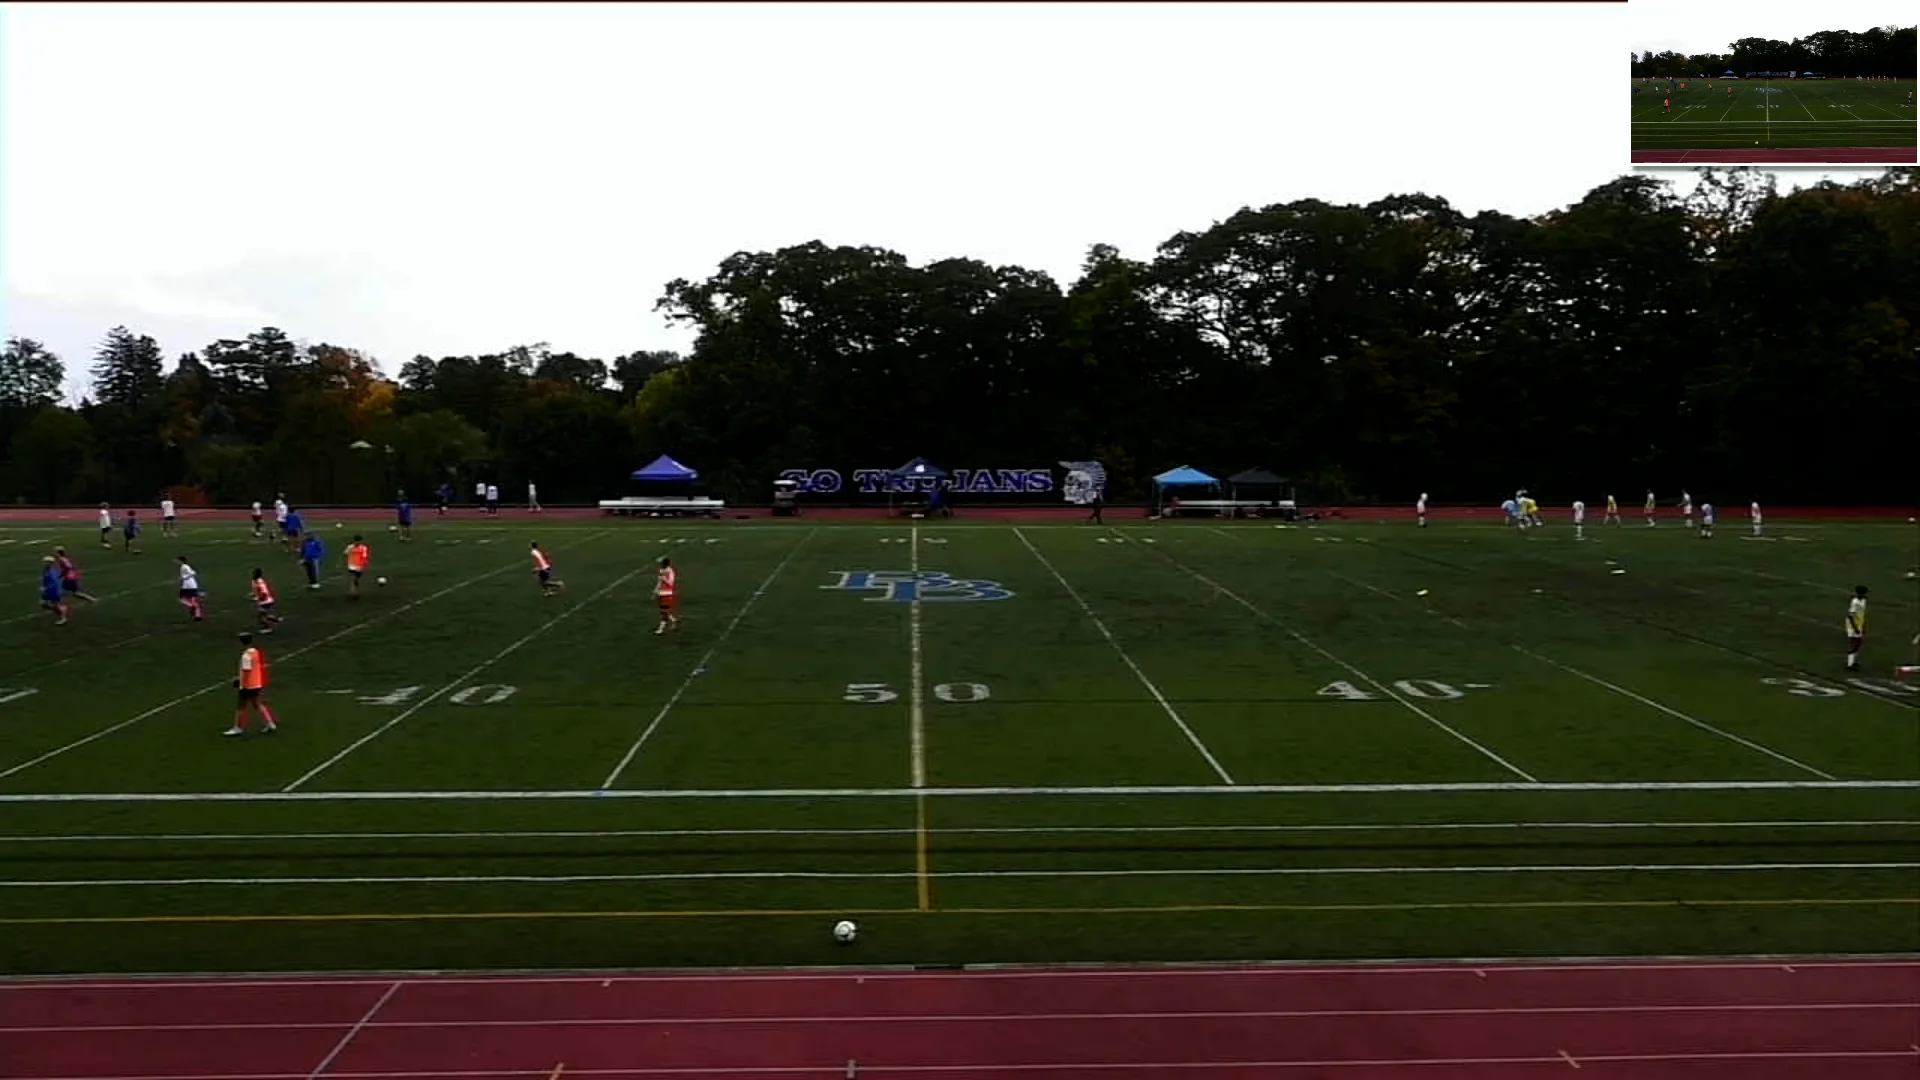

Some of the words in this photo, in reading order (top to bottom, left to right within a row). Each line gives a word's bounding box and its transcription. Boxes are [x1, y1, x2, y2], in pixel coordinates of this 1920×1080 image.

[780, 469, 842, 493] GO
[841, 682, 991, 702] 50
[1316, 680, 1464, 700] 40
